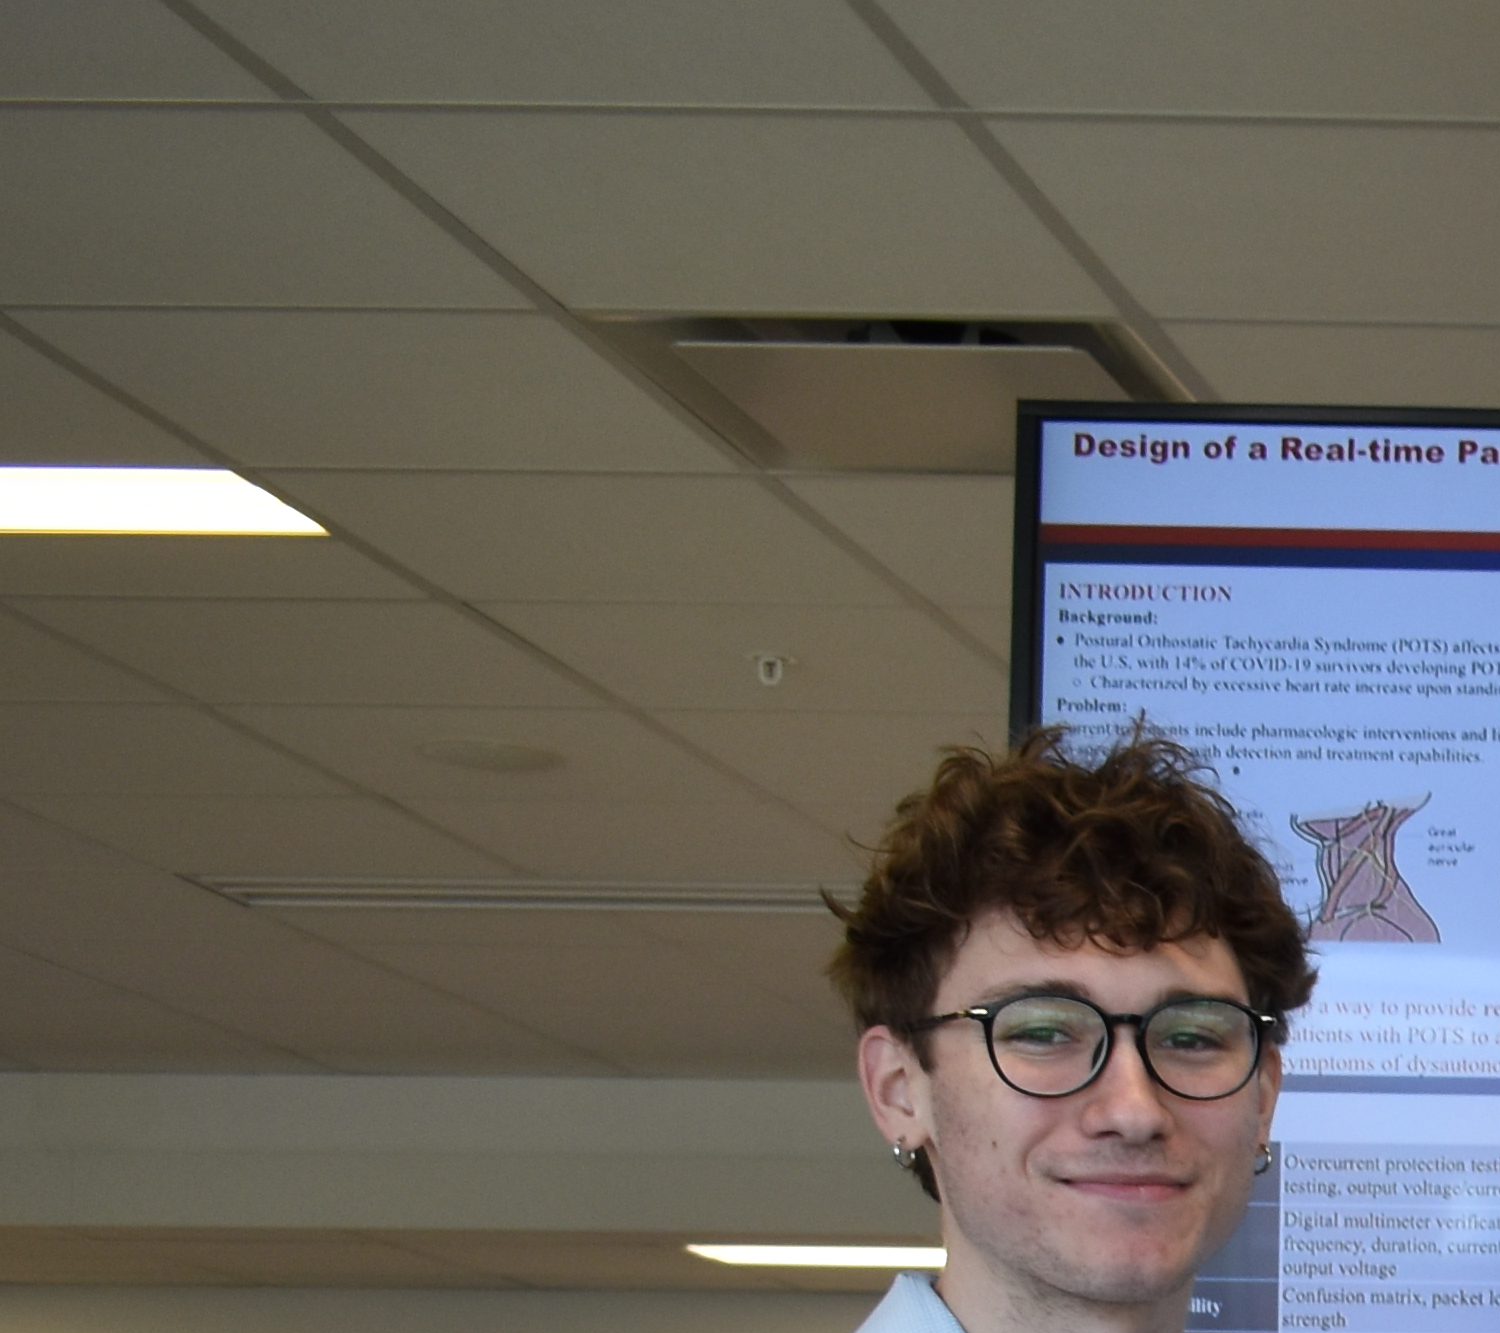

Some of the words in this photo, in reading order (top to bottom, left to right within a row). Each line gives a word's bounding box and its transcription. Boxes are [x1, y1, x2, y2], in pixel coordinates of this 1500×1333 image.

[1074, 432, 1189, 464] Design
[1203, 435, 1236, 459] of
[1248, 441, 1266, 460] a
[1281, 436, 1444, 463] Real-time
[1059, 582, 1231, 601] INTRODUCTION
[1284, 1153, 1380, 1171] Overcurrent
[1385, 1155, 1465, 1176] protection
